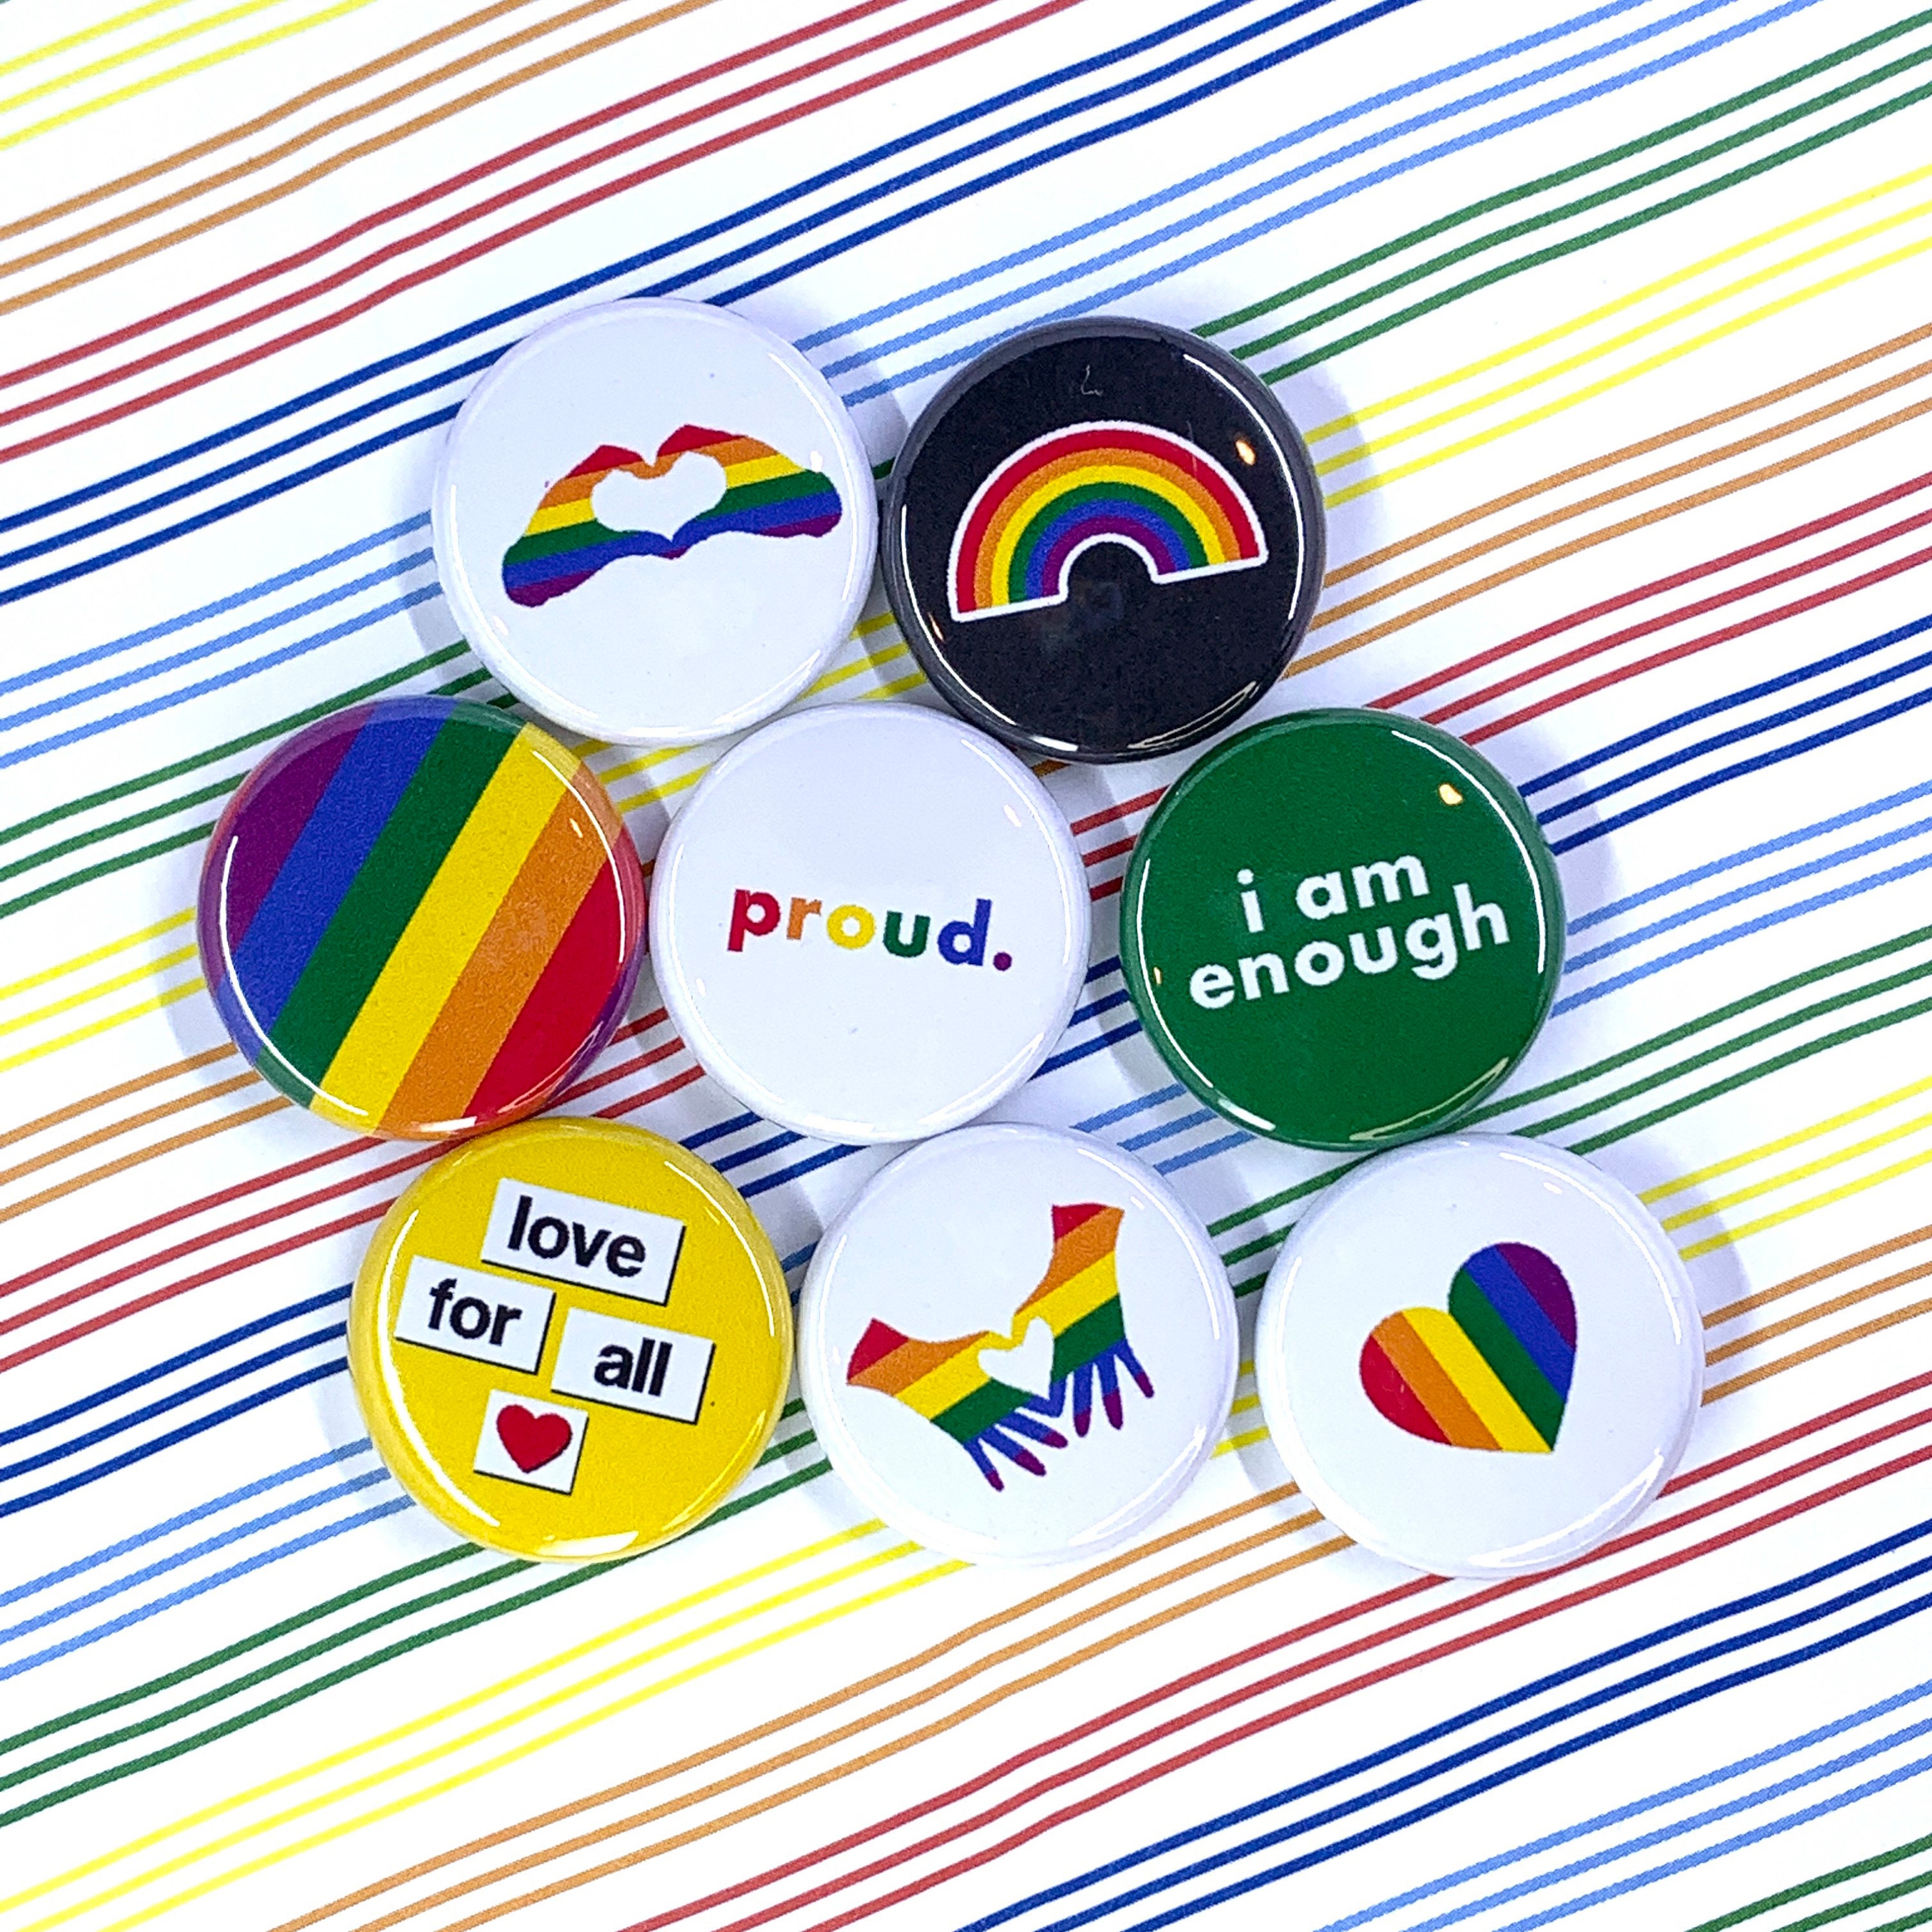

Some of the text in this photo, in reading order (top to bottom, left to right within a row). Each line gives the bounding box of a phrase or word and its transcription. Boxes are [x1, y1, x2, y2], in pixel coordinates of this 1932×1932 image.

[728, 889, 1012, 971] proud.
[1237, 855, 1430, 933] i am
[1190, 883, 1510, 1009] enough
[508, 1195, 645, 1277] love
[428, 1279, 672, 1396] for all
